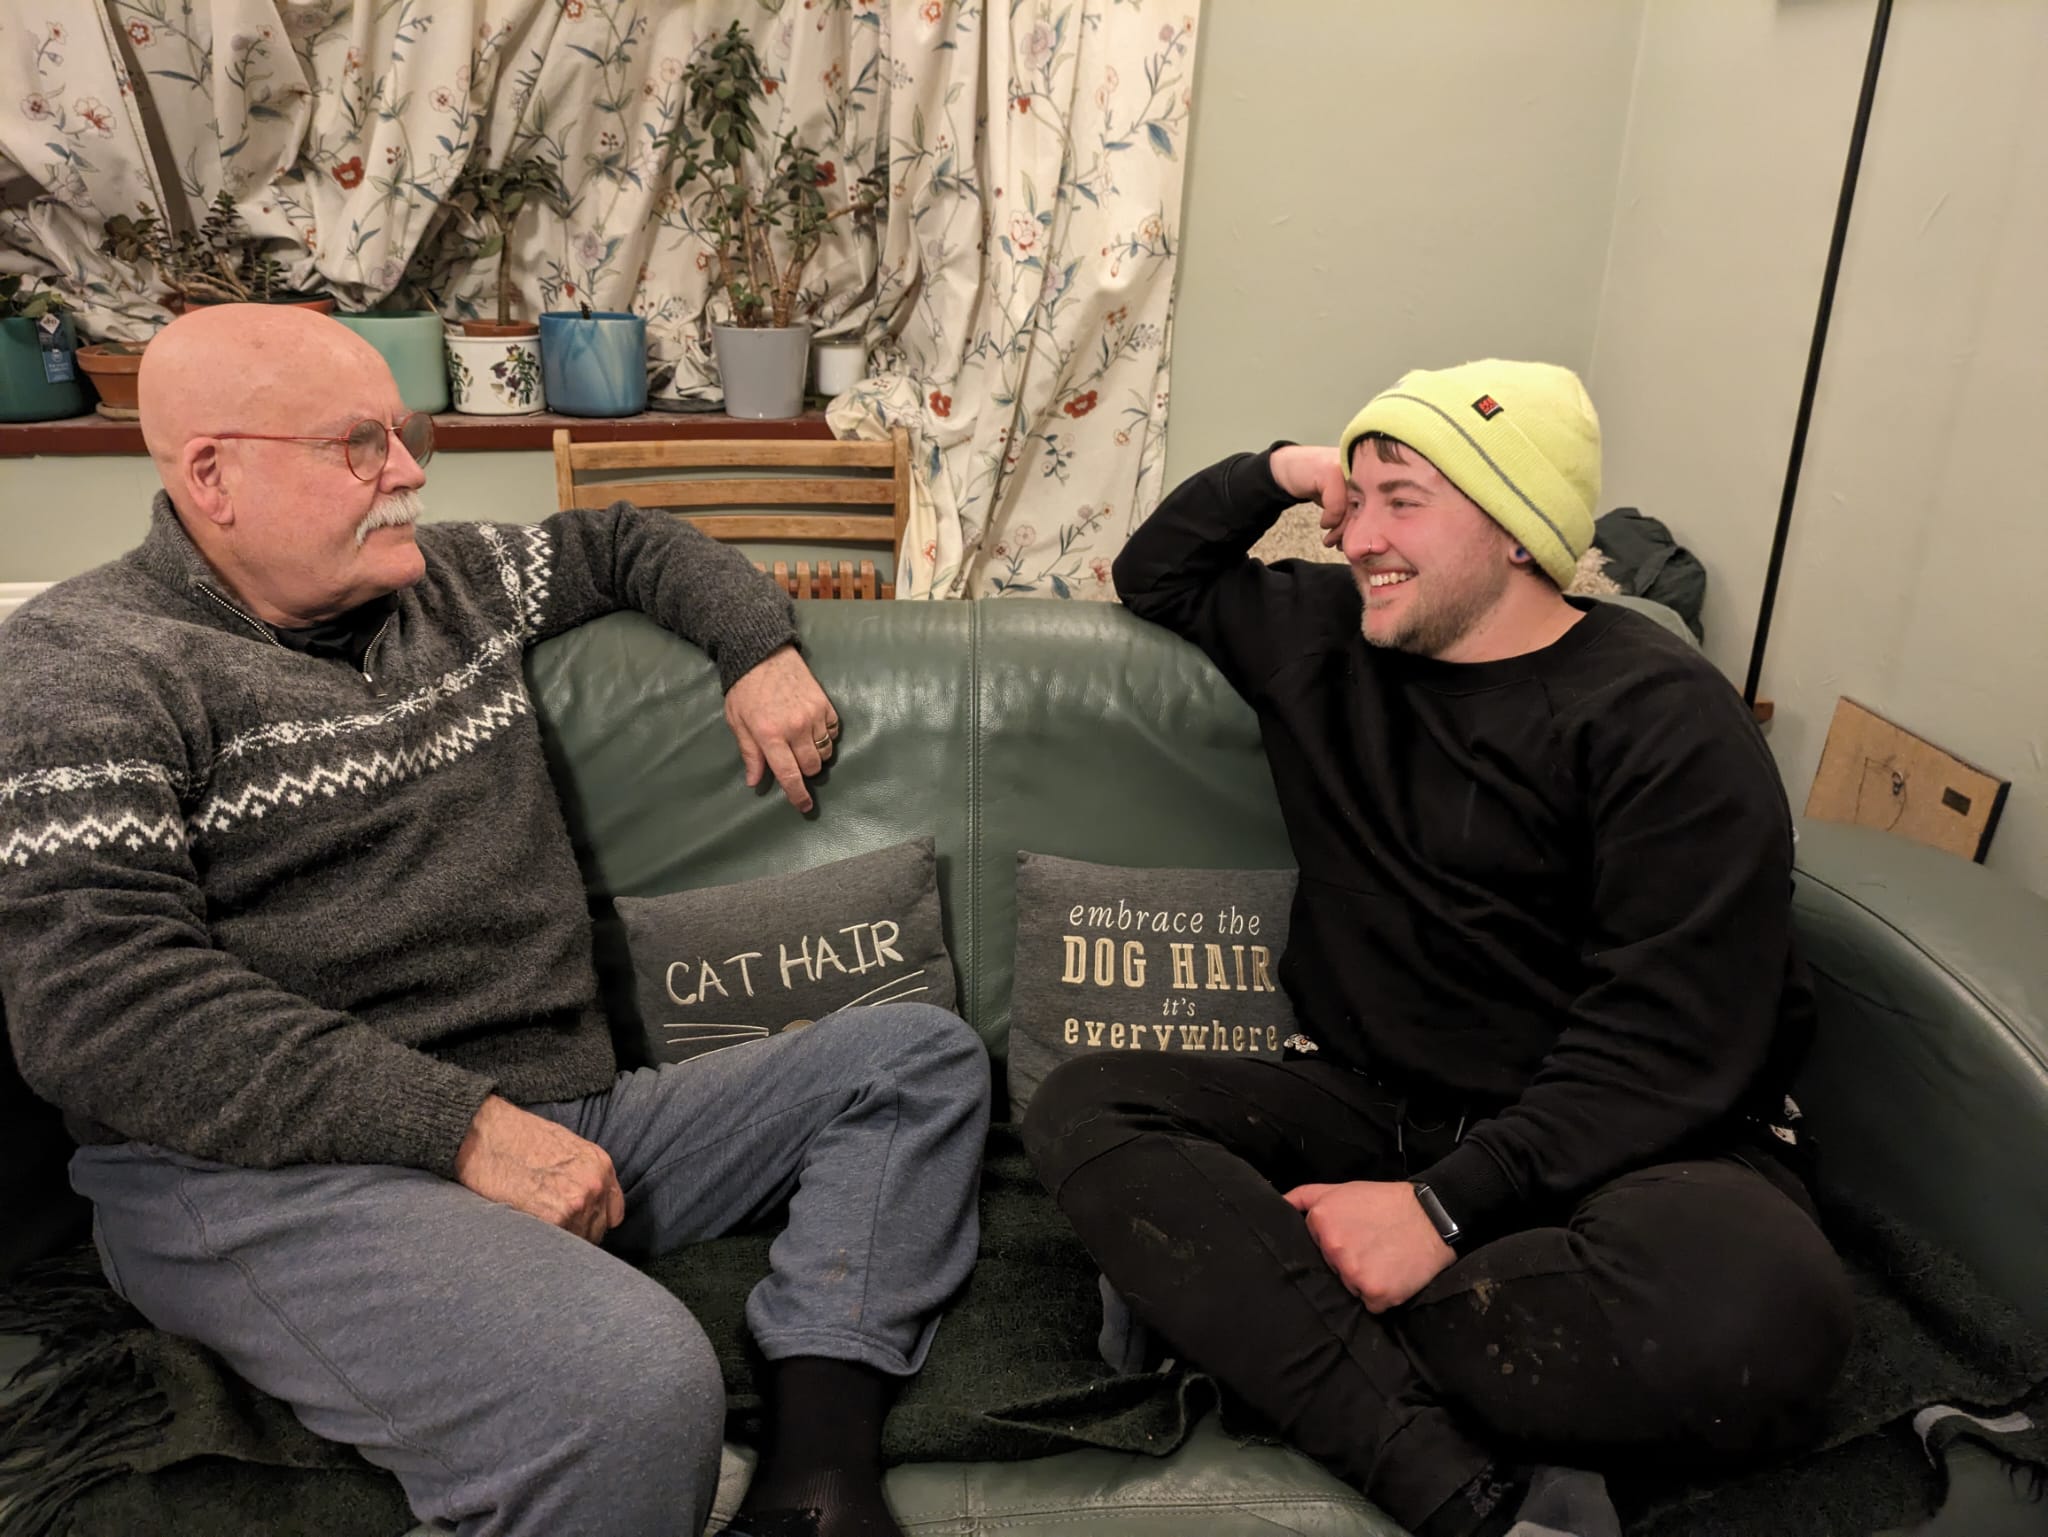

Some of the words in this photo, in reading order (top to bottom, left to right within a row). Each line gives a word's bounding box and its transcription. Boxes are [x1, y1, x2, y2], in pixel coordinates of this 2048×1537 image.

[1069, 899, 1204, 934] embrace
[1218, 905, 1261, 936] the
[666, 952, 763, 1006] CAT
[779, 920, 904, 990] HAIR
[1061, 935, 1147, 988] DOG
[1169, 942, 1276, 993] HAIR
[1162, 997, 1197, 1017] it's
[1064, 1017, 1279, 1052] everywhere
